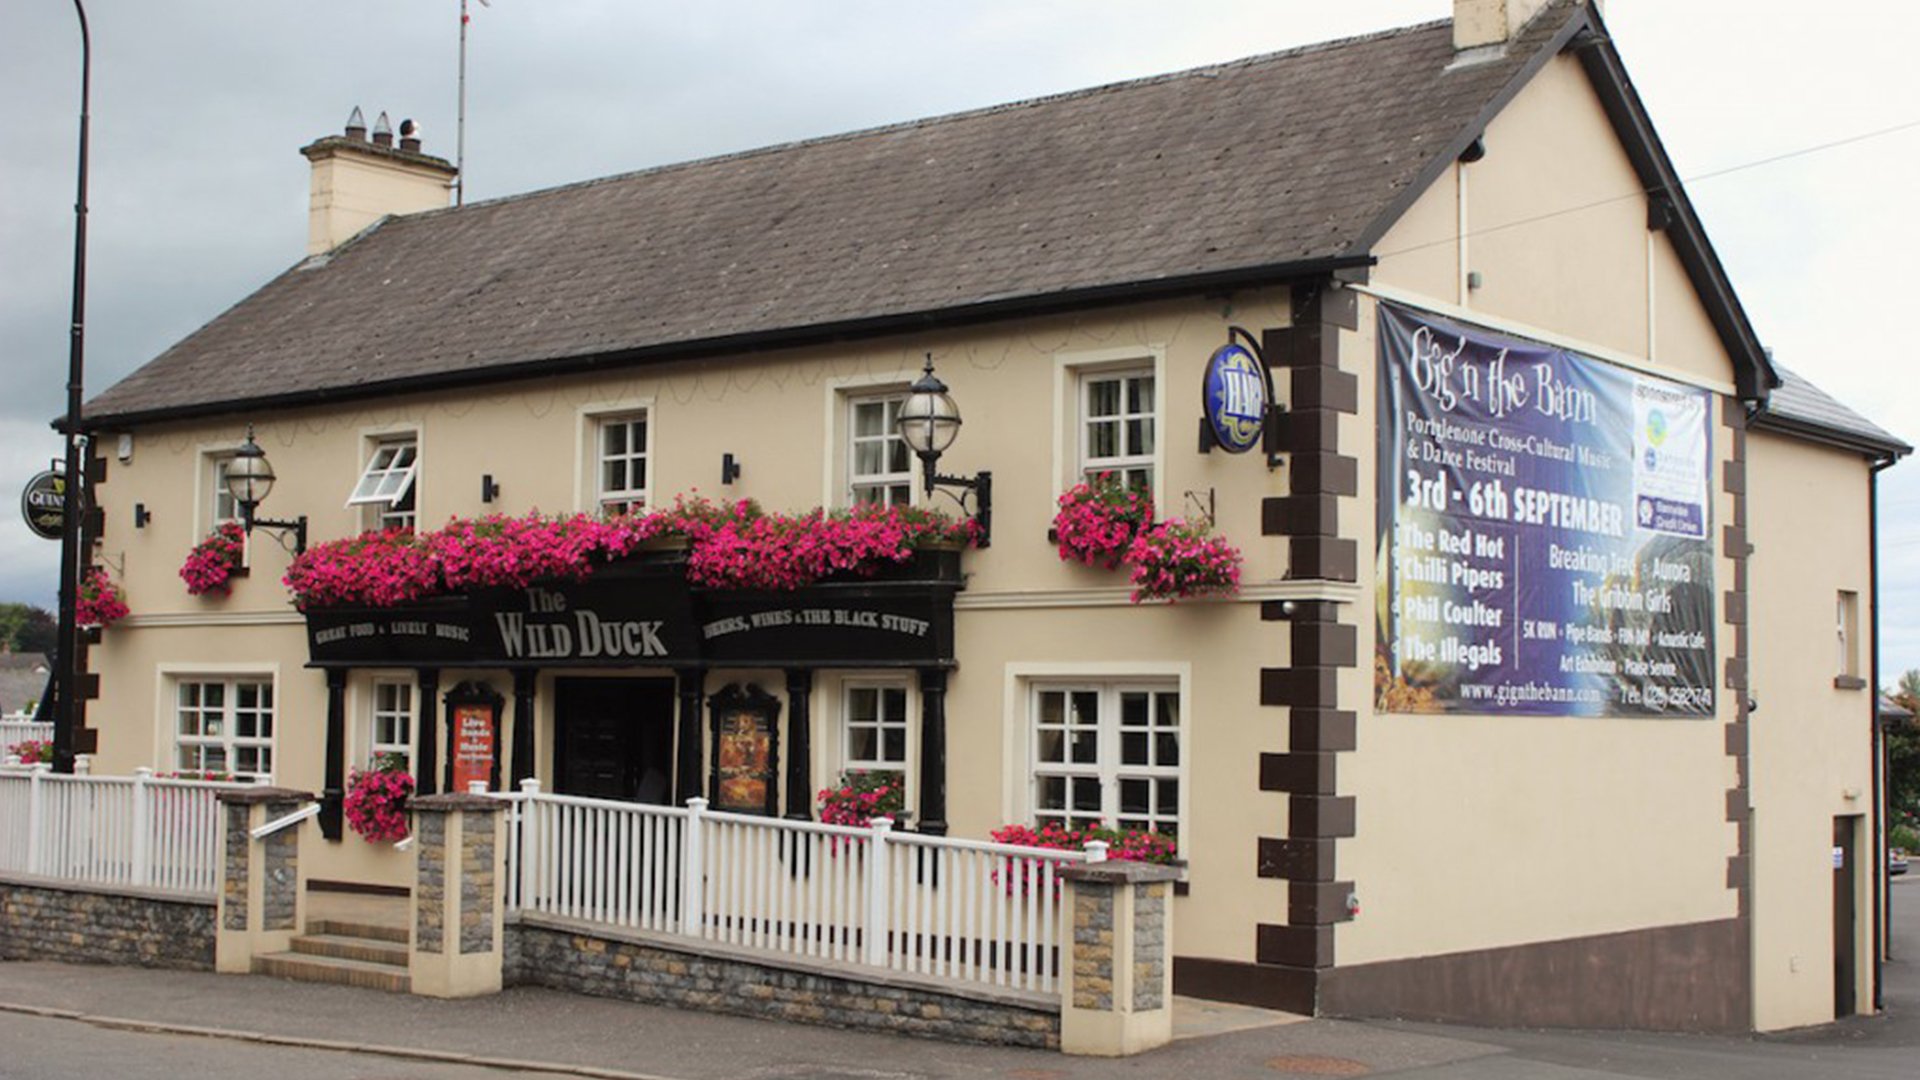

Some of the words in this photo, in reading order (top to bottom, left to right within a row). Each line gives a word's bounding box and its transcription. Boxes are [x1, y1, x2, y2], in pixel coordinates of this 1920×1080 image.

[1487, 347, 1530, 418] the
[1531, 363, 1596, 426] Bann
[1407, 411, 1486, 446] Portglenone
[1488, 428, 1575, 463] Cross-Cultural
[1577, 444, 1612, 470] Music
[1407, 438, 1419, 459] &
[1423, 440, 1463, 468] Dance
[1466, 450, 1515, 477] Festival
[1407, 469, 1447, 512] 3rd
[1469, 479, 1508, 521] 6th
[1514, 486, 1624, 538] SEPTEMBER
[1404, 522, 1434, 550] The
[1439, 527, 1471, 555] Red
[1475, 533, 1504, 560] Hot
[1404, 554, 1447, 584] Chilli
[1452, 560, 1504, 594] Pipers
[1550, 543, 1608, 579] Breaking
[1653, 556, 1692, 583] Aurora
[526, 587, 566, 613] The
[1404, 594, 1438, 622] Phil
[1443, 600, 1503, 628] Coulter
[1572, 578, 1596, 606] The
[1645, 588, 1672, 614] Girls
[315, 625, 347, 645] GREAT
[349, 621, 375, 637] FOOD
[391, 621, 427, 636] LIVELY
[435, 622, 471, 642] MUSIC
[494, 611, 573, 658] WILD
[573, 609, 669, 657] DUCK
[751, 609, 793, 629] WINES
[802, 609, 831, 625] THE
[834, 609, 879, 629] BLACK
[881, 613, 930, 637] STUFF
[1586, 624, 1613, 644] Bands
[1404, 633, 1435, 661] The
[1441, 636, 1502, 671] Illegals
[1560, 653, 1574, 673] Art
[1460, 680, 1601, 707] www.gignthebann.com
